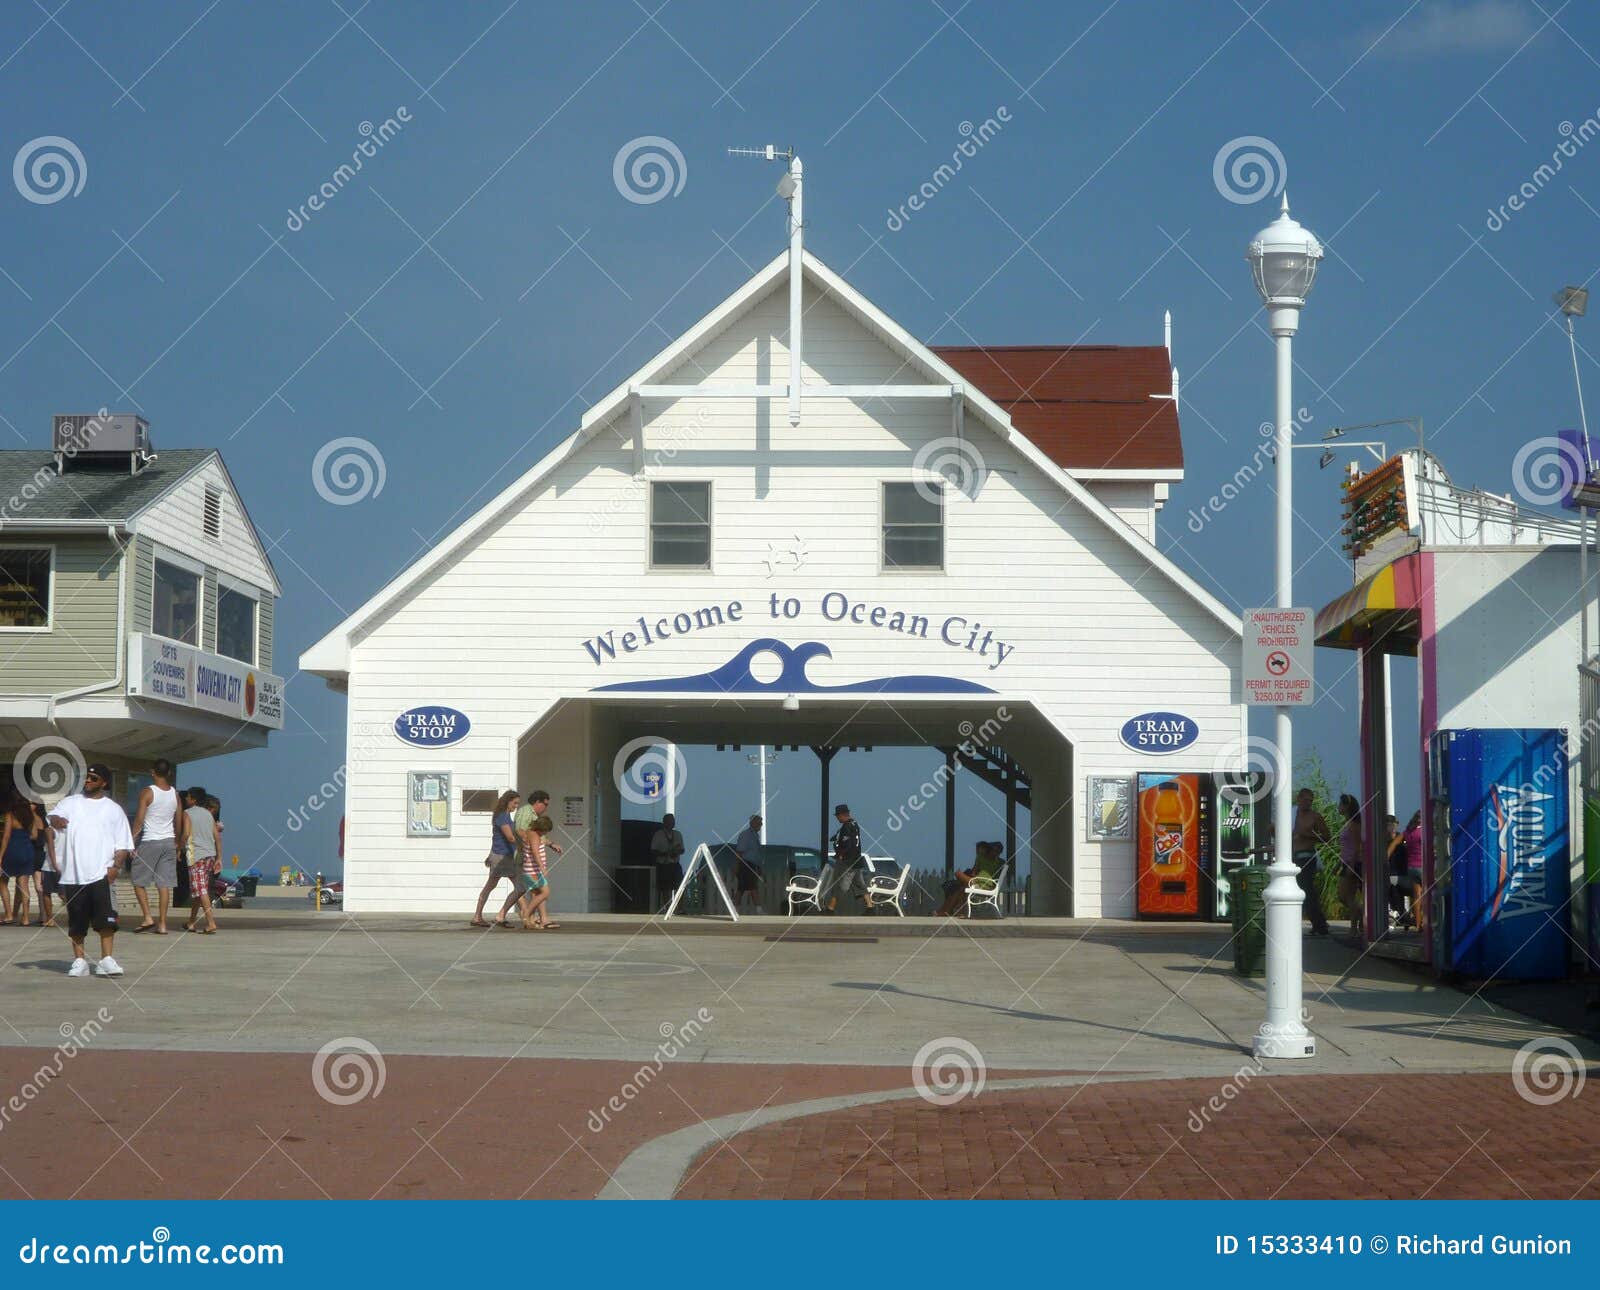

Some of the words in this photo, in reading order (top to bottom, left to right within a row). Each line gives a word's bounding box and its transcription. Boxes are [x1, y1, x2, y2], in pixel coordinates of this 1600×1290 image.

[1250, 612, 1305, 622] UNAUTHORIZED
[581, 599, 743, 667] Welcome
[768, 593, 801, 619] to
[821, 592, 929, 639] Ocean
[940, 615, 1015, 671] City
[1261, 624, 1296, 634] VEHICLES
[1257, 637, 1299, 647] PROHIBITED
[161, 643, 177, 660] GIFTS
[152, 660, 185, 681] SOUVENIRS
[152, 679, 164, 693] SEA
[165, 682, 186, 699] SHELLS
[196, 664, 228, 700] SOUVENIR
[227, 675, 242, 704] CITY
[1246, 679, 1271, 689] PERMIT
[1274, 679, 1311, 689] REQUIRED
[1254, 691, 1284, 702] $250.00
[1286, 692, 1303, 702] FINE
[404, 713, 456, 727] TRAM
[1133, 720, 1186, 733] TRAM
[409, 726, 454, 739] STOP
[1138, 733, 1183, 746] STOP
[1156, 834, 1181, 852] Dole
[1496, 784, 1555, 922] AQUAFINA
